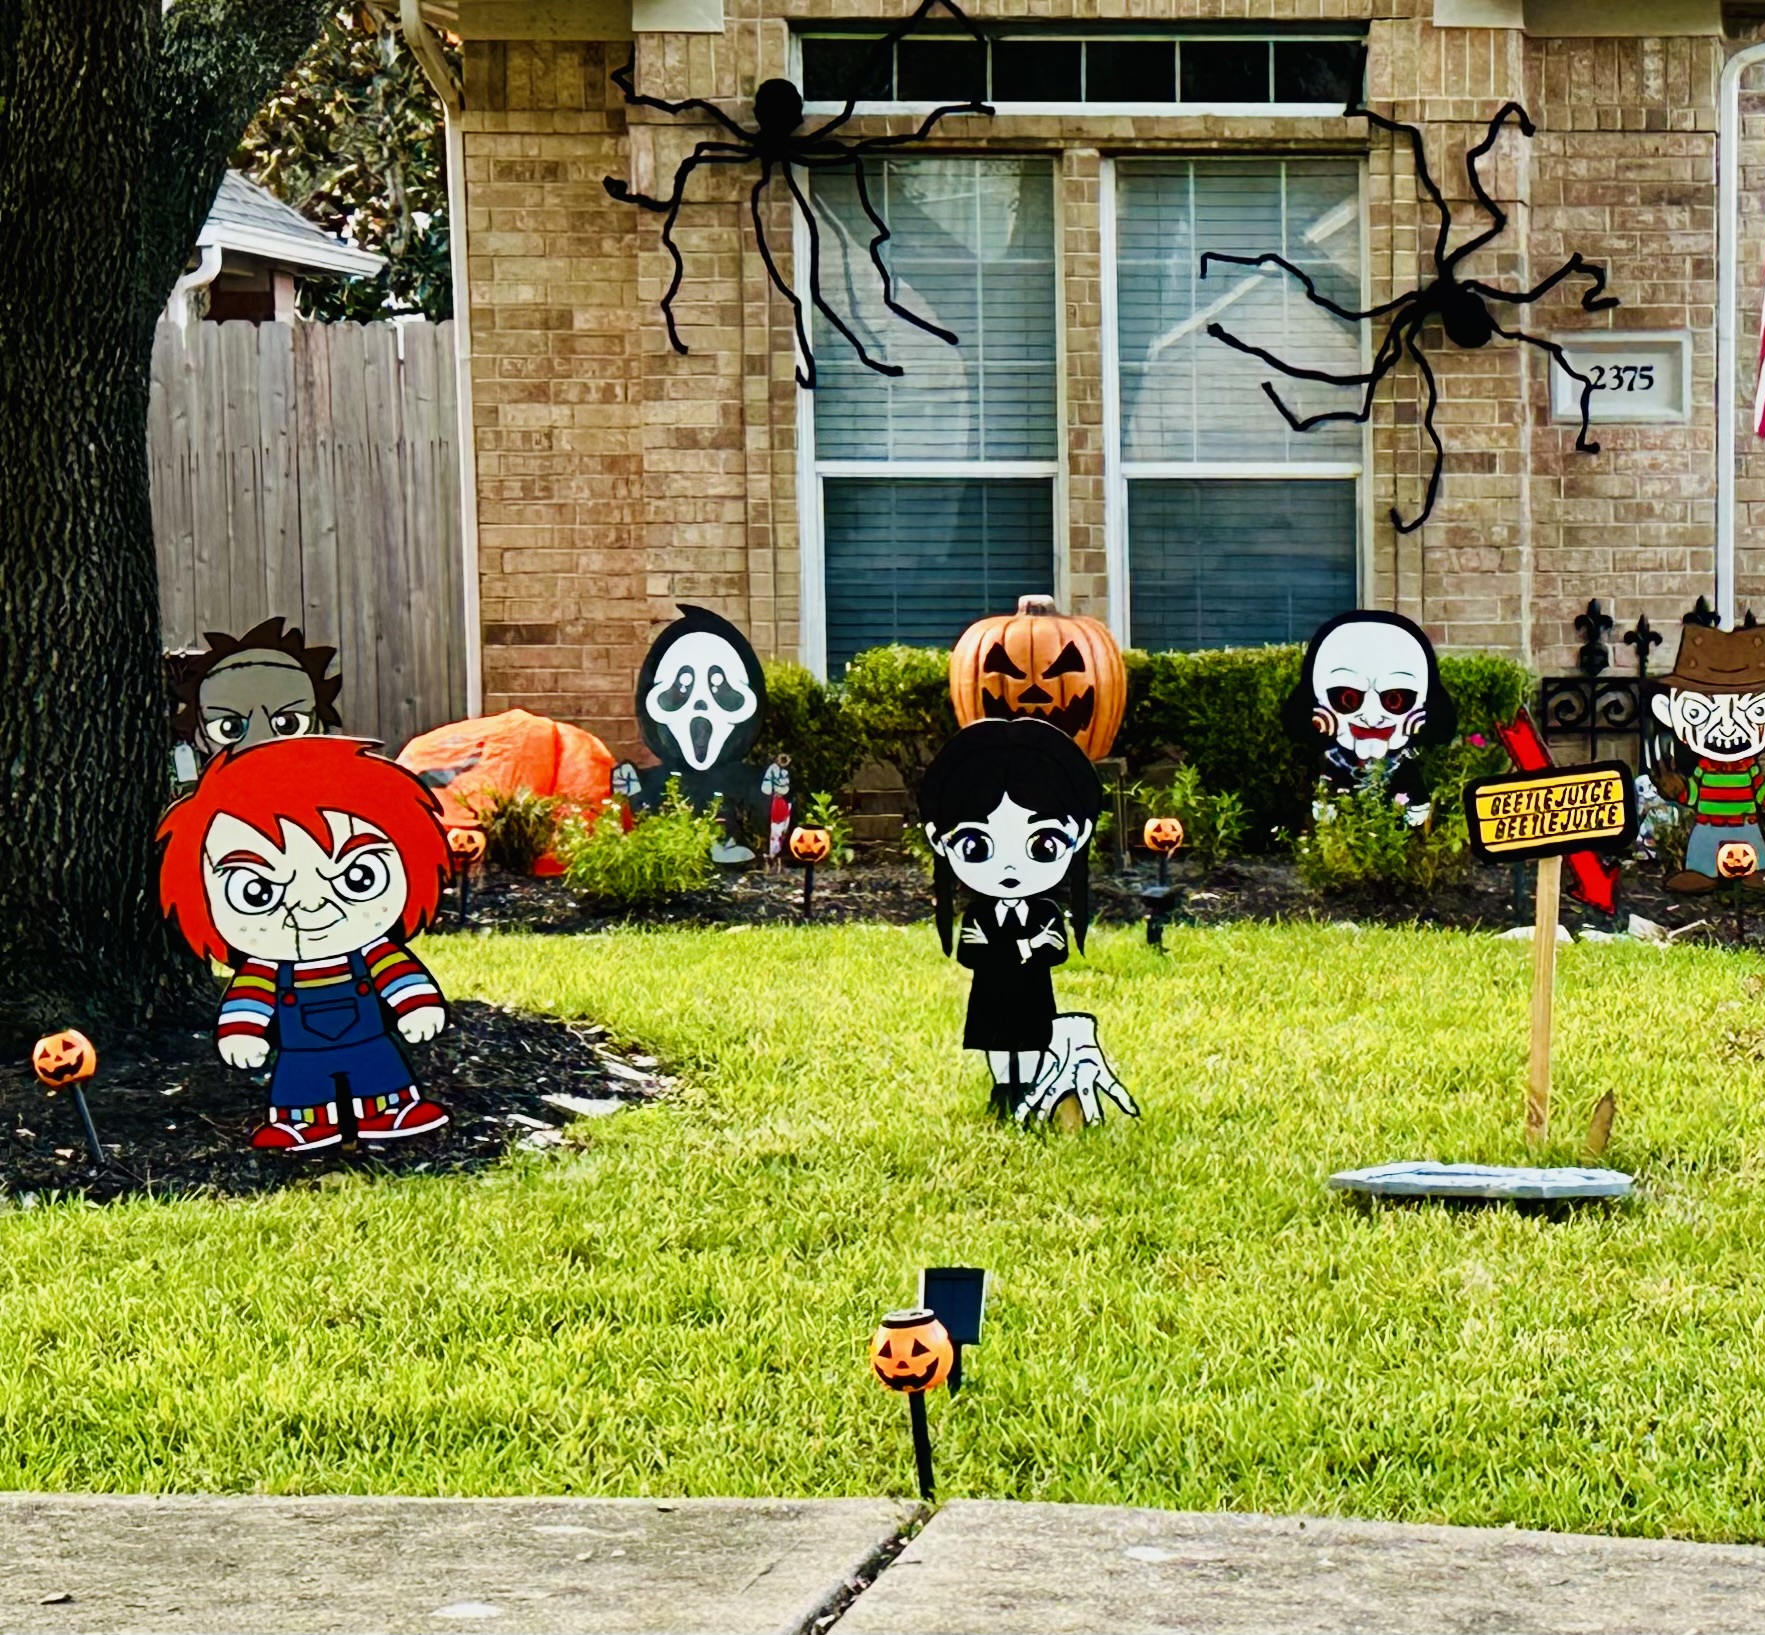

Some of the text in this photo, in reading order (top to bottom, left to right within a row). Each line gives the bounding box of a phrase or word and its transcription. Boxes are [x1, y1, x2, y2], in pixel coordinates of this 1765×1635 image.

[1590, 365, 1654, 391] 2375
[1491, 781, 1613, 816] BEETLEJUICE
[1495, 805, 1617, 839] BEETLEJUICE
